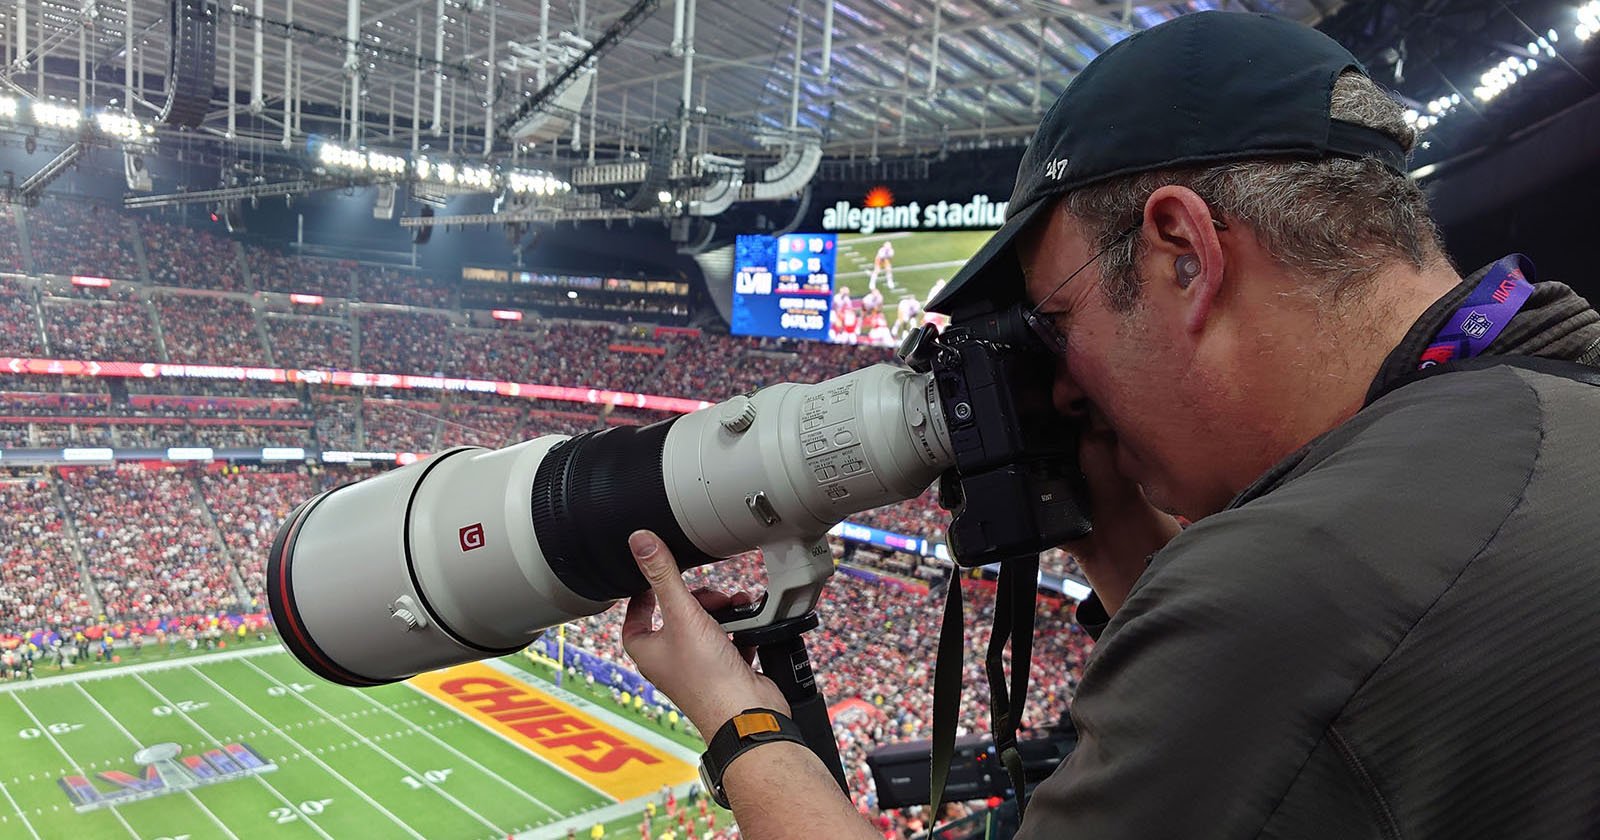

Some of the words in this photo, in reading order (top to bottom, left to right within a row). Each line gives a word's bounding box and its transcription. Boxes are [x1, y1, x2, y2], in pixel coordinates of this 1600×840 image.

[823, 201, 921, 233] allegiant
[924, 194, 1007, 228] stadiu
[1464, 321, 1484, 338] NFL
[438, 677, 664, 773] CHIEFS
[400, 769, 448, 789] 10
[269, 801, 325, 824] 20
